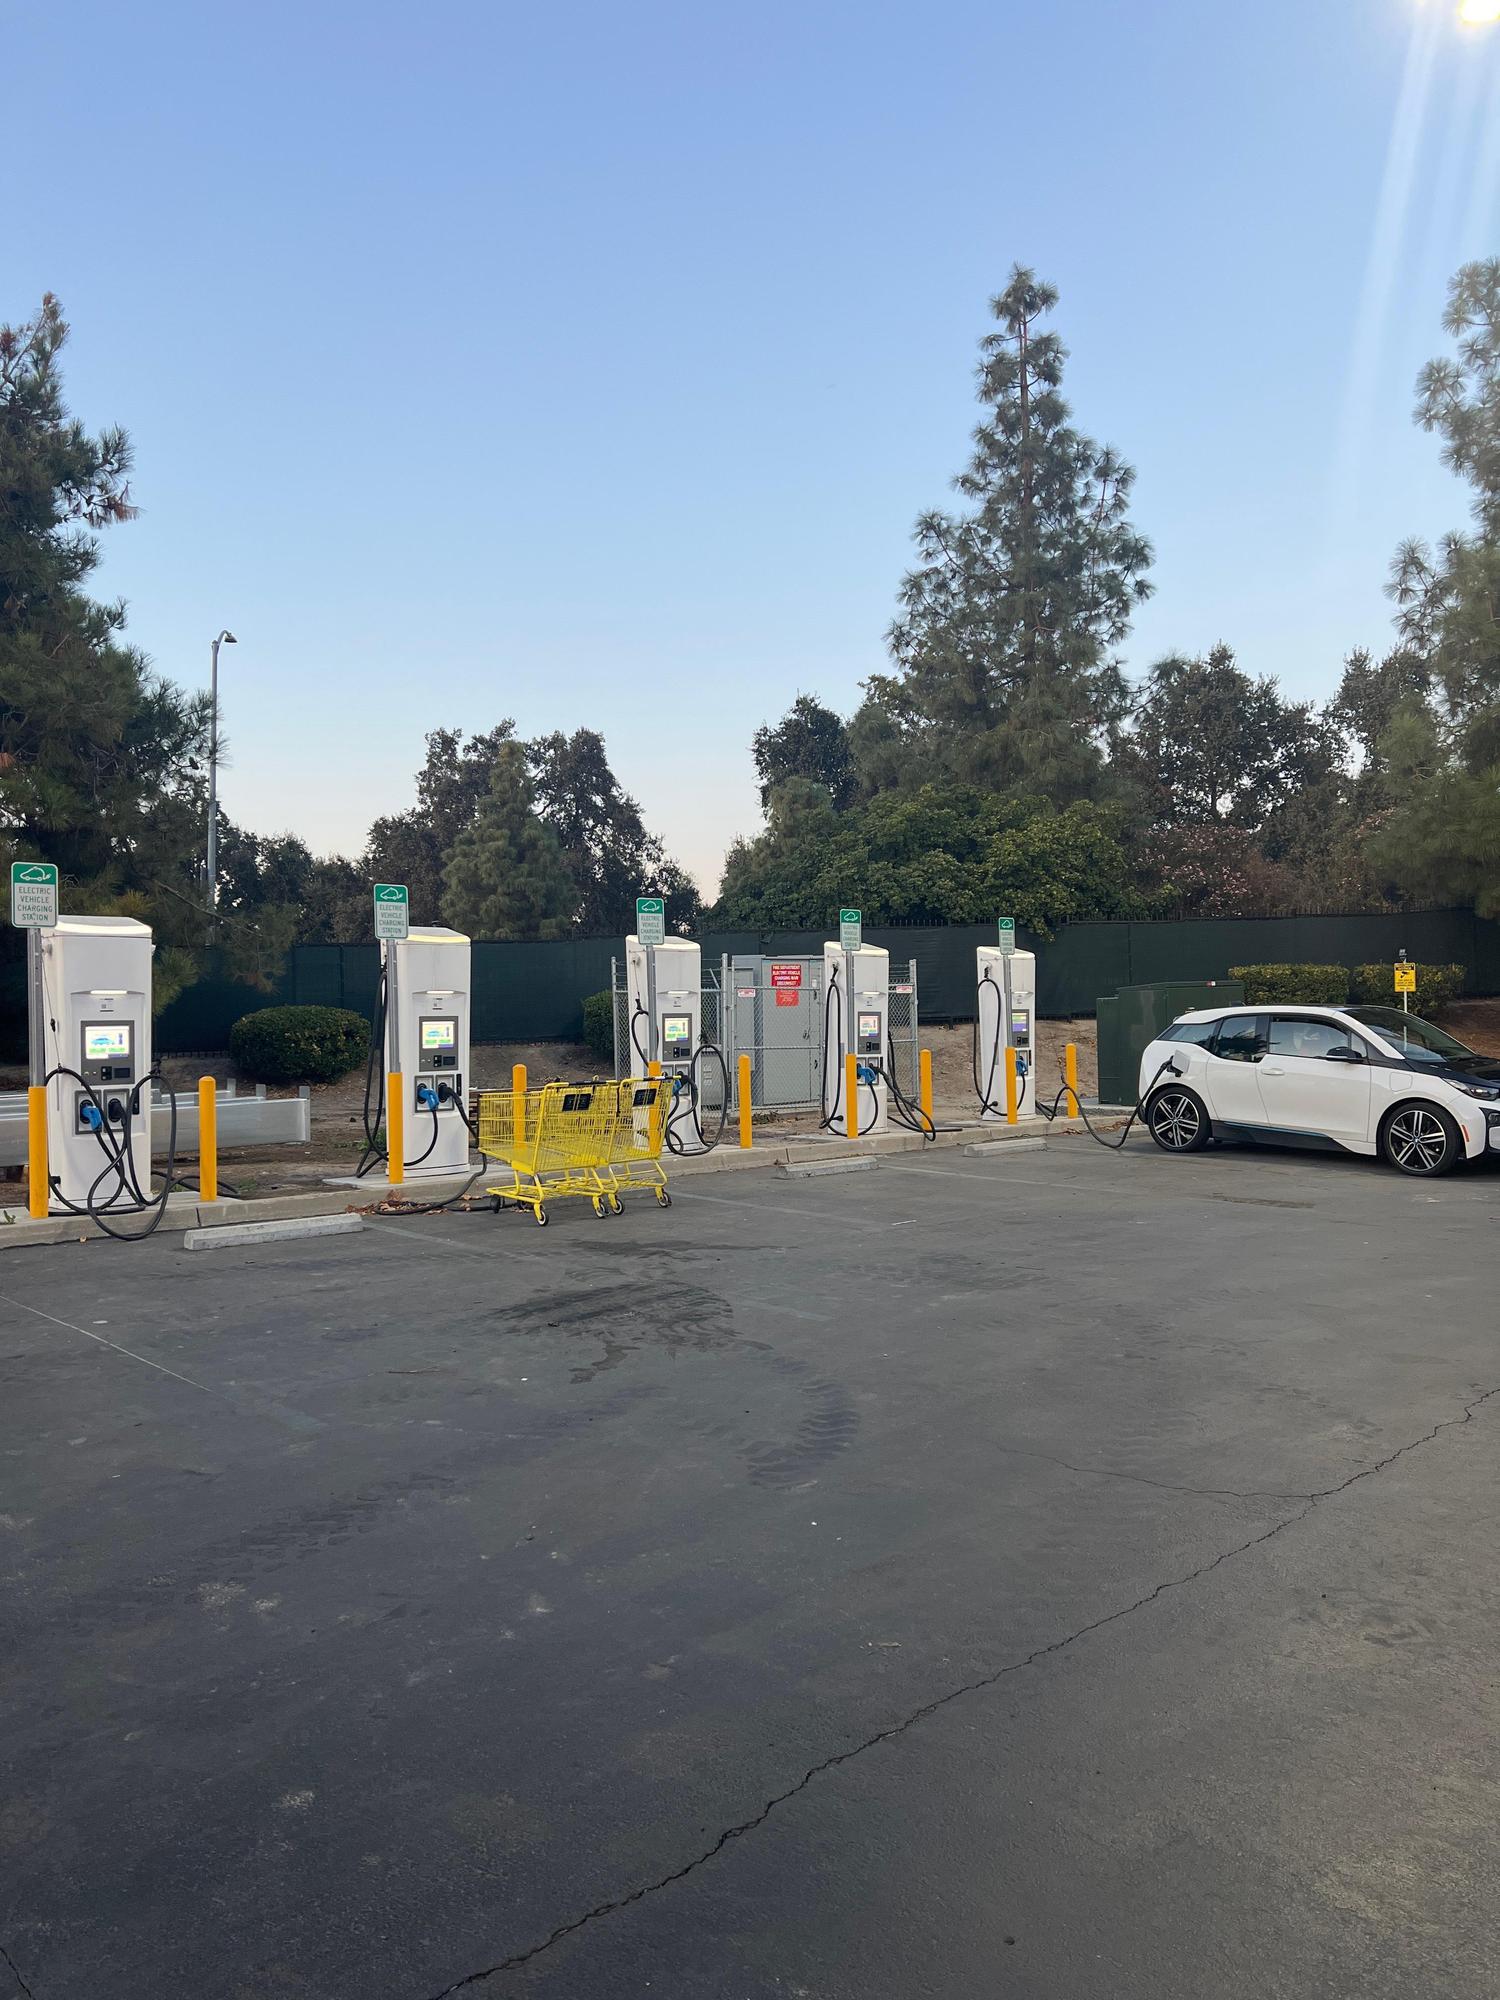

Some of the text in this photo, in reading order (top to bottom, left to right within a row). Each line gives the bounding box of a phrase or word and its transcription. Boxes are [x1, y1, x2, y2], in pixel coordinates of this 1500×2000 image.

[18, 886, 51, 894] ELECTRIC
[20, 896, 49, 904] VEHICLE
[17, 904, 52, 912] CHARGING
